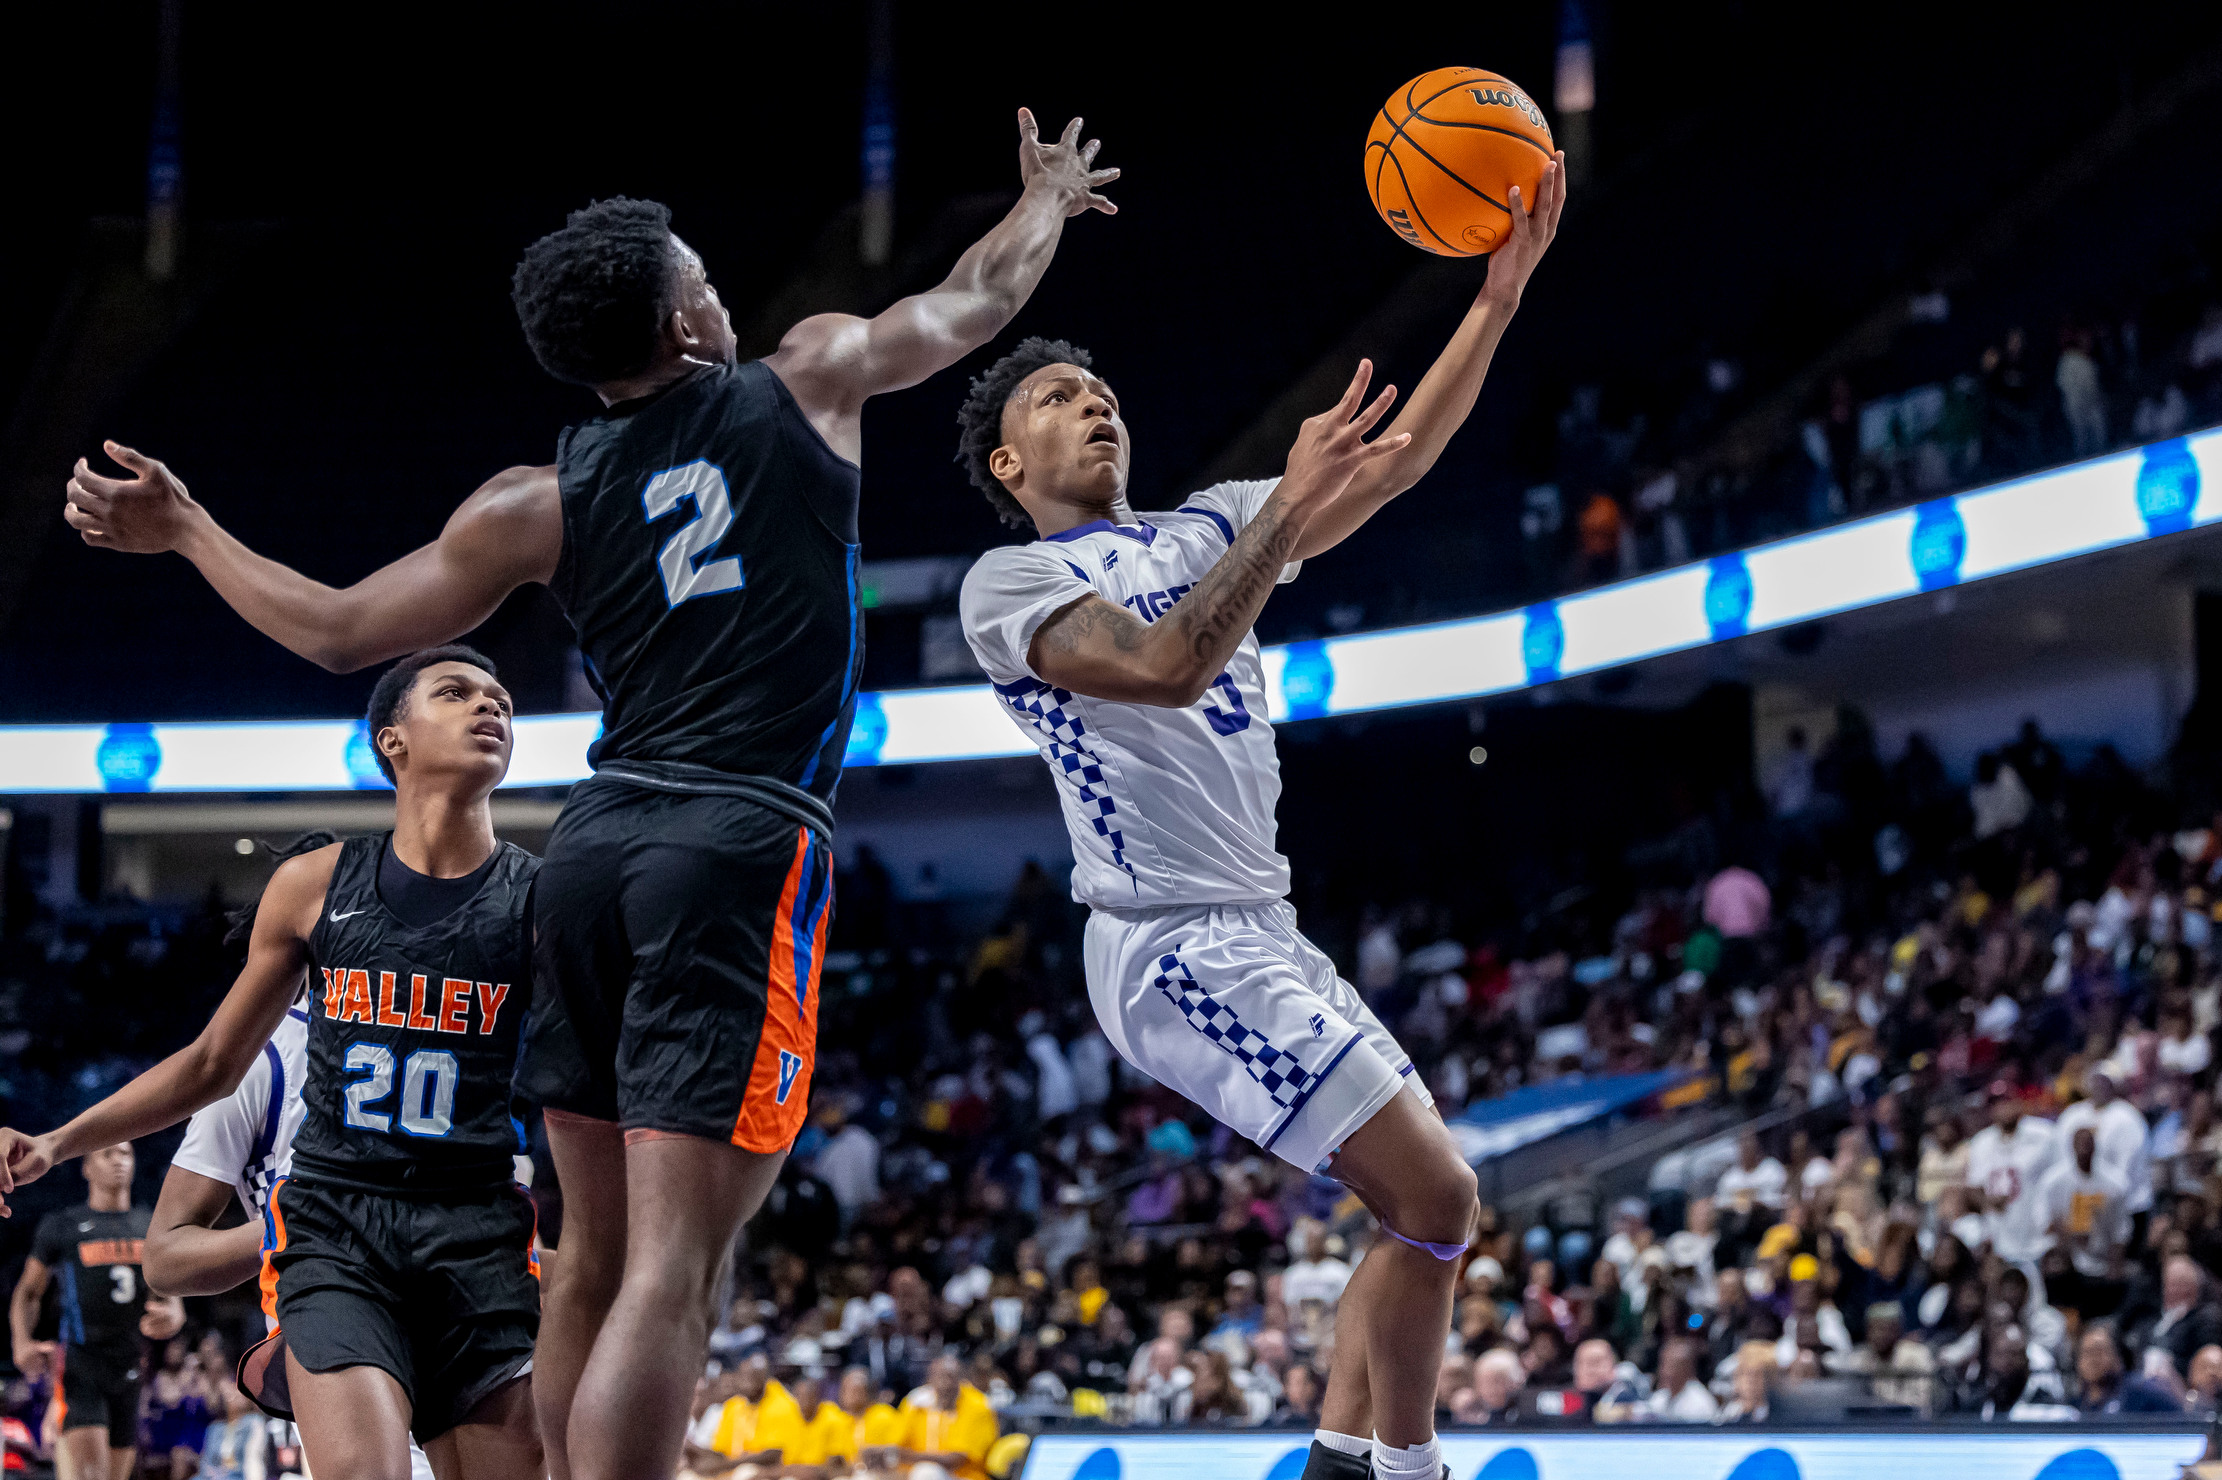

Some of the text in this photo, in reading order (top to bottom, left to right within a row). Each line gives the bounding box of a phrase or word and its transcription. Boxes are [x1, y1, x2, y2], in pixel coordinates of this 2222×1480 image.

[641, 457, 745, 611] 2
[321, 967, 511, 1035] VALLEY
[342, 1041, 460, 1137] 20
[109, 1265, 136, 1304] 3
